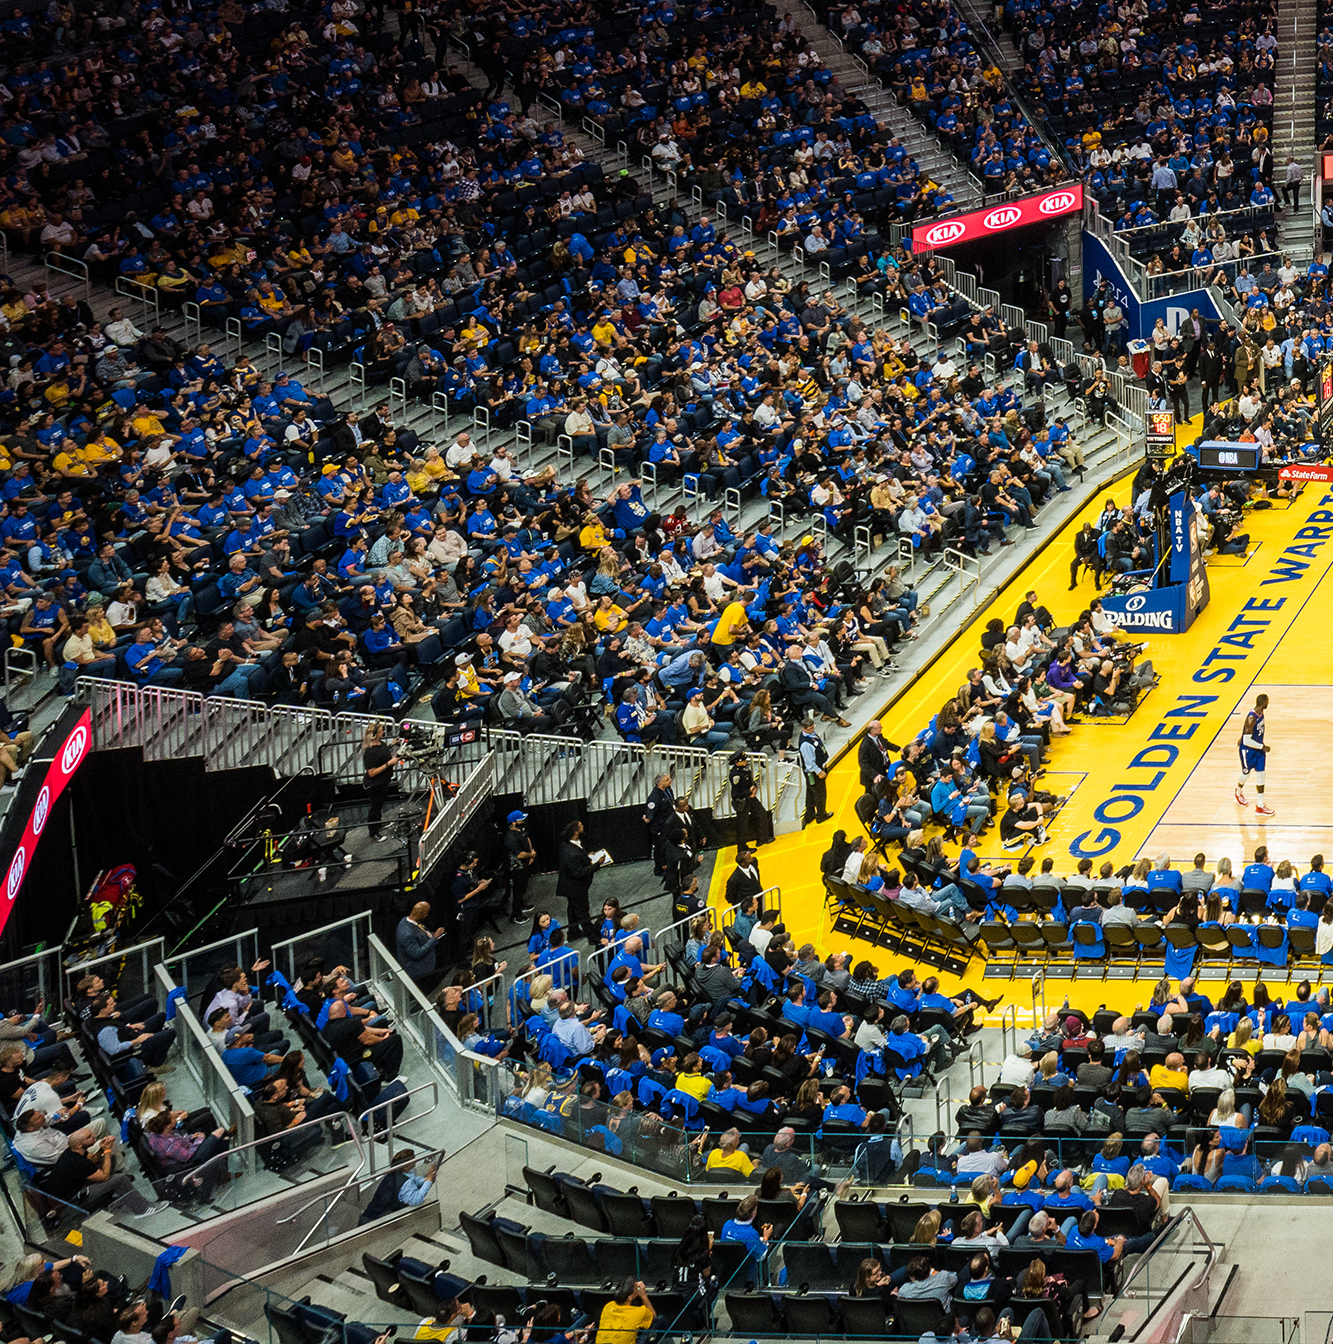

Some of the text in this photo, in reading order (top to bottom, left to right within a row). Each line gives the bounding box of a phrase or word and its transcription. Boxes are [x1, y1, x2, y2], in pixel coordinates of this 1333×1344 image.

[1156, 423, 1167, 434] 18
[1218, 452, 1239, 466] @NBA
[1069, 692, 1224, 860] GOLDEN
[1193, 596, 1288, 684] STATE
